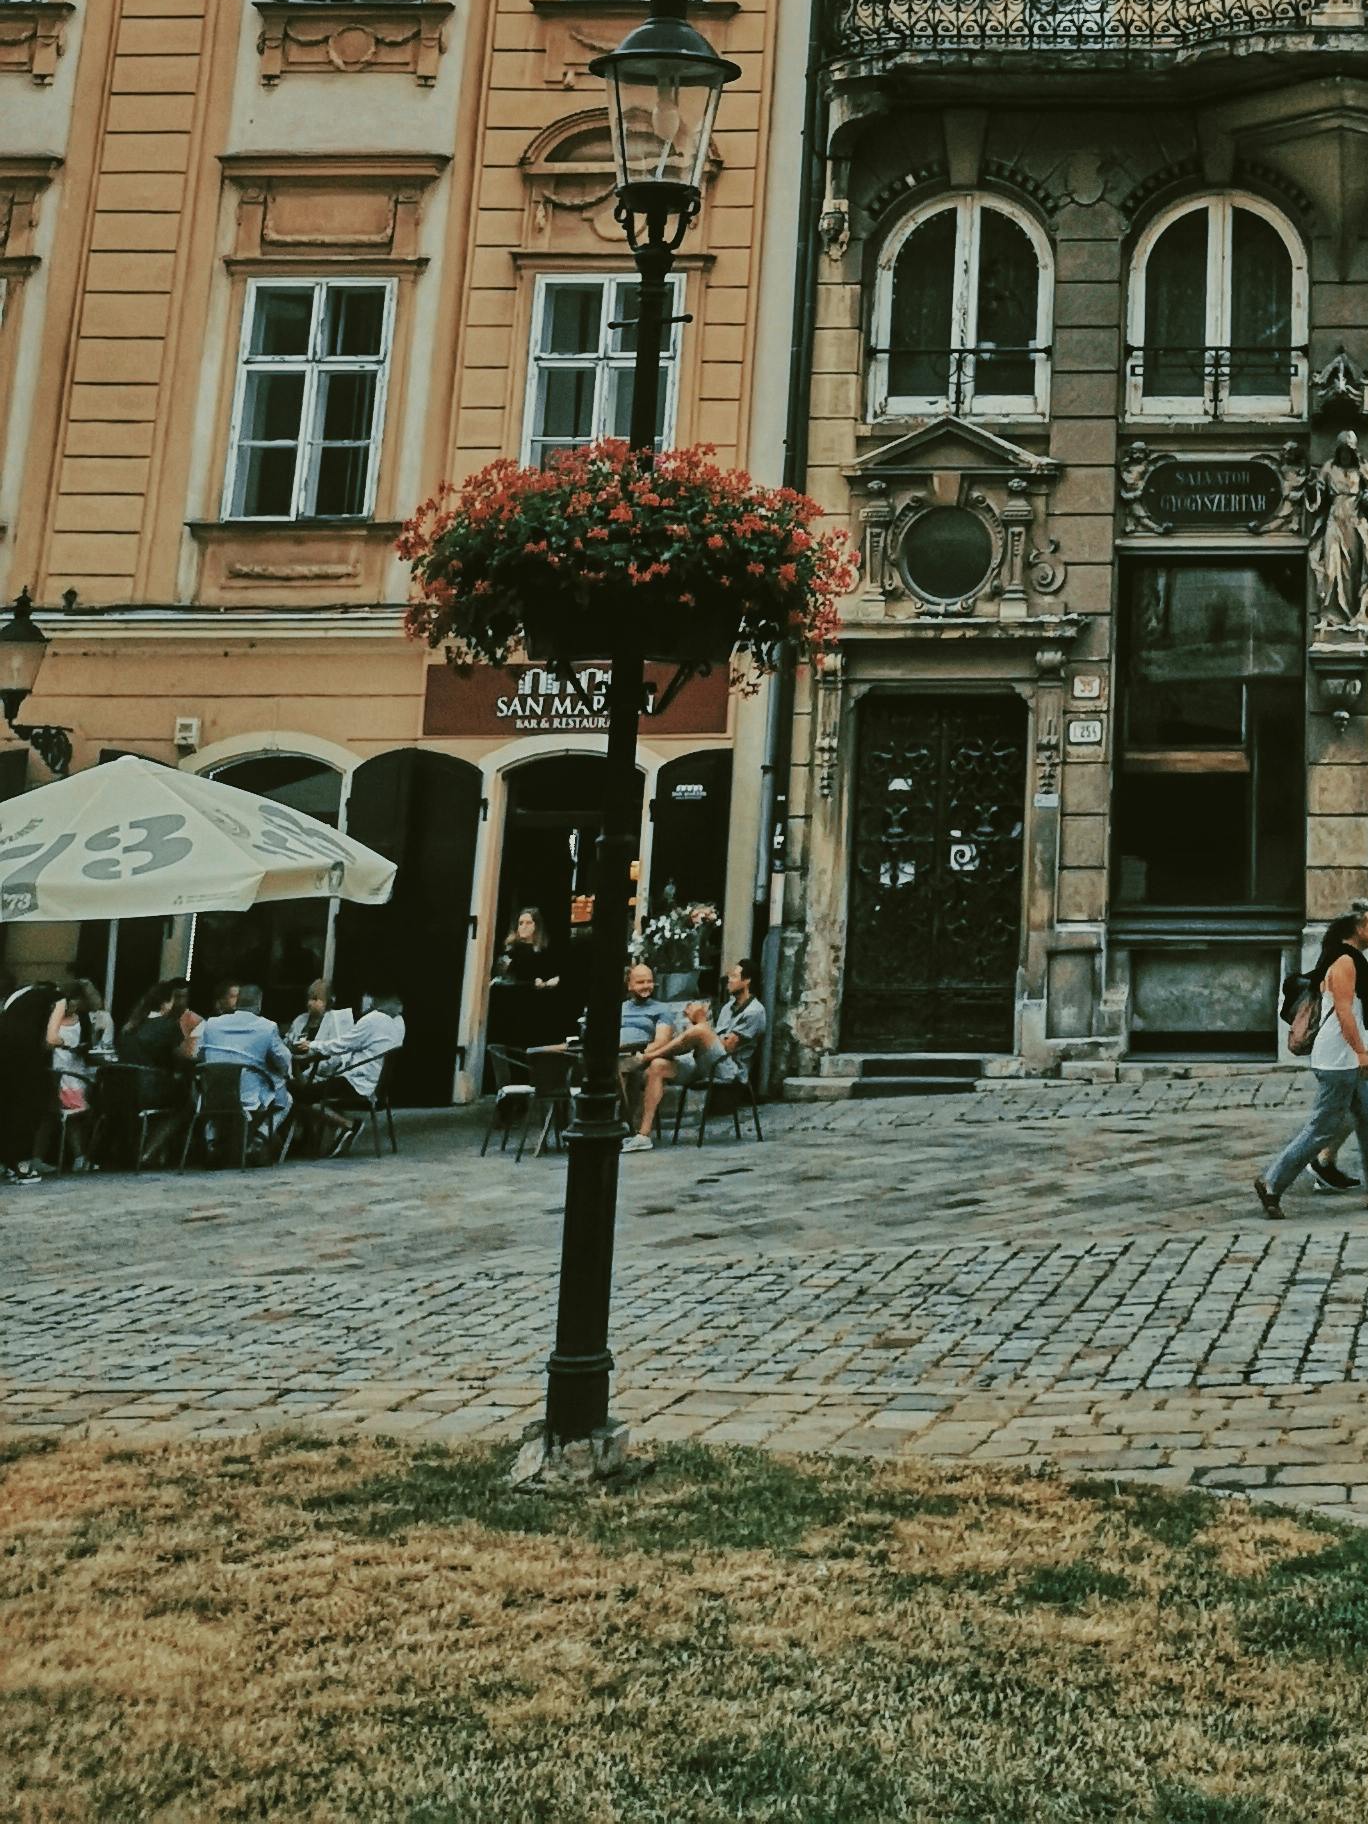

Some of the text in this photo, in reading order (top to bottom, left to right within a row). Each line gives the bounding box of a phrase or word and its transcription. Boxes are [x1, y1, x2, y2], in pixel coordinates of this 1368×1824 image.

[496, 695, 654, 717] SAN MARN
[515, 718, 538, 729] BAR
[540, 717, 550, 729] &
